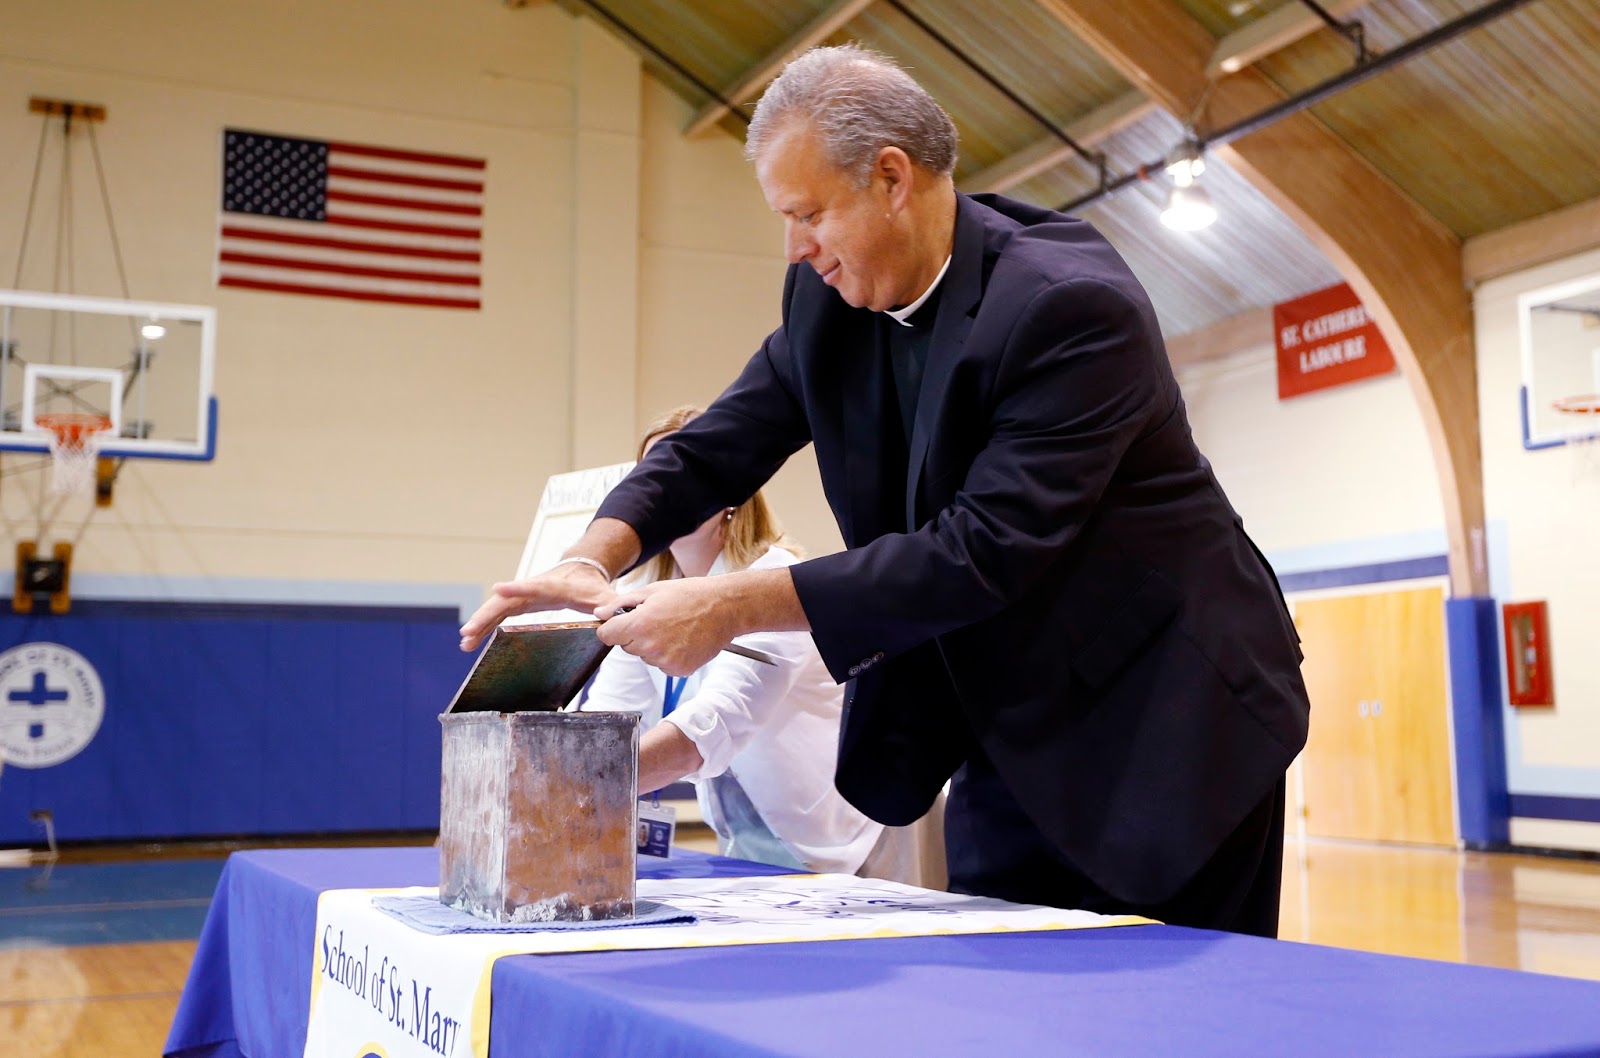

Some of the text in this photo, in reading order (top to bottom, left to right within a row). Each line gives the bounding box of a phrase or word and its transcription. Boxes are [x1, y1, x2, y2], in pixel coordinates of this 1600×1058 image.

[1299, 336, 1365, 372] LABOURE
[322, 924, 461, 1058] School of St. Mary
